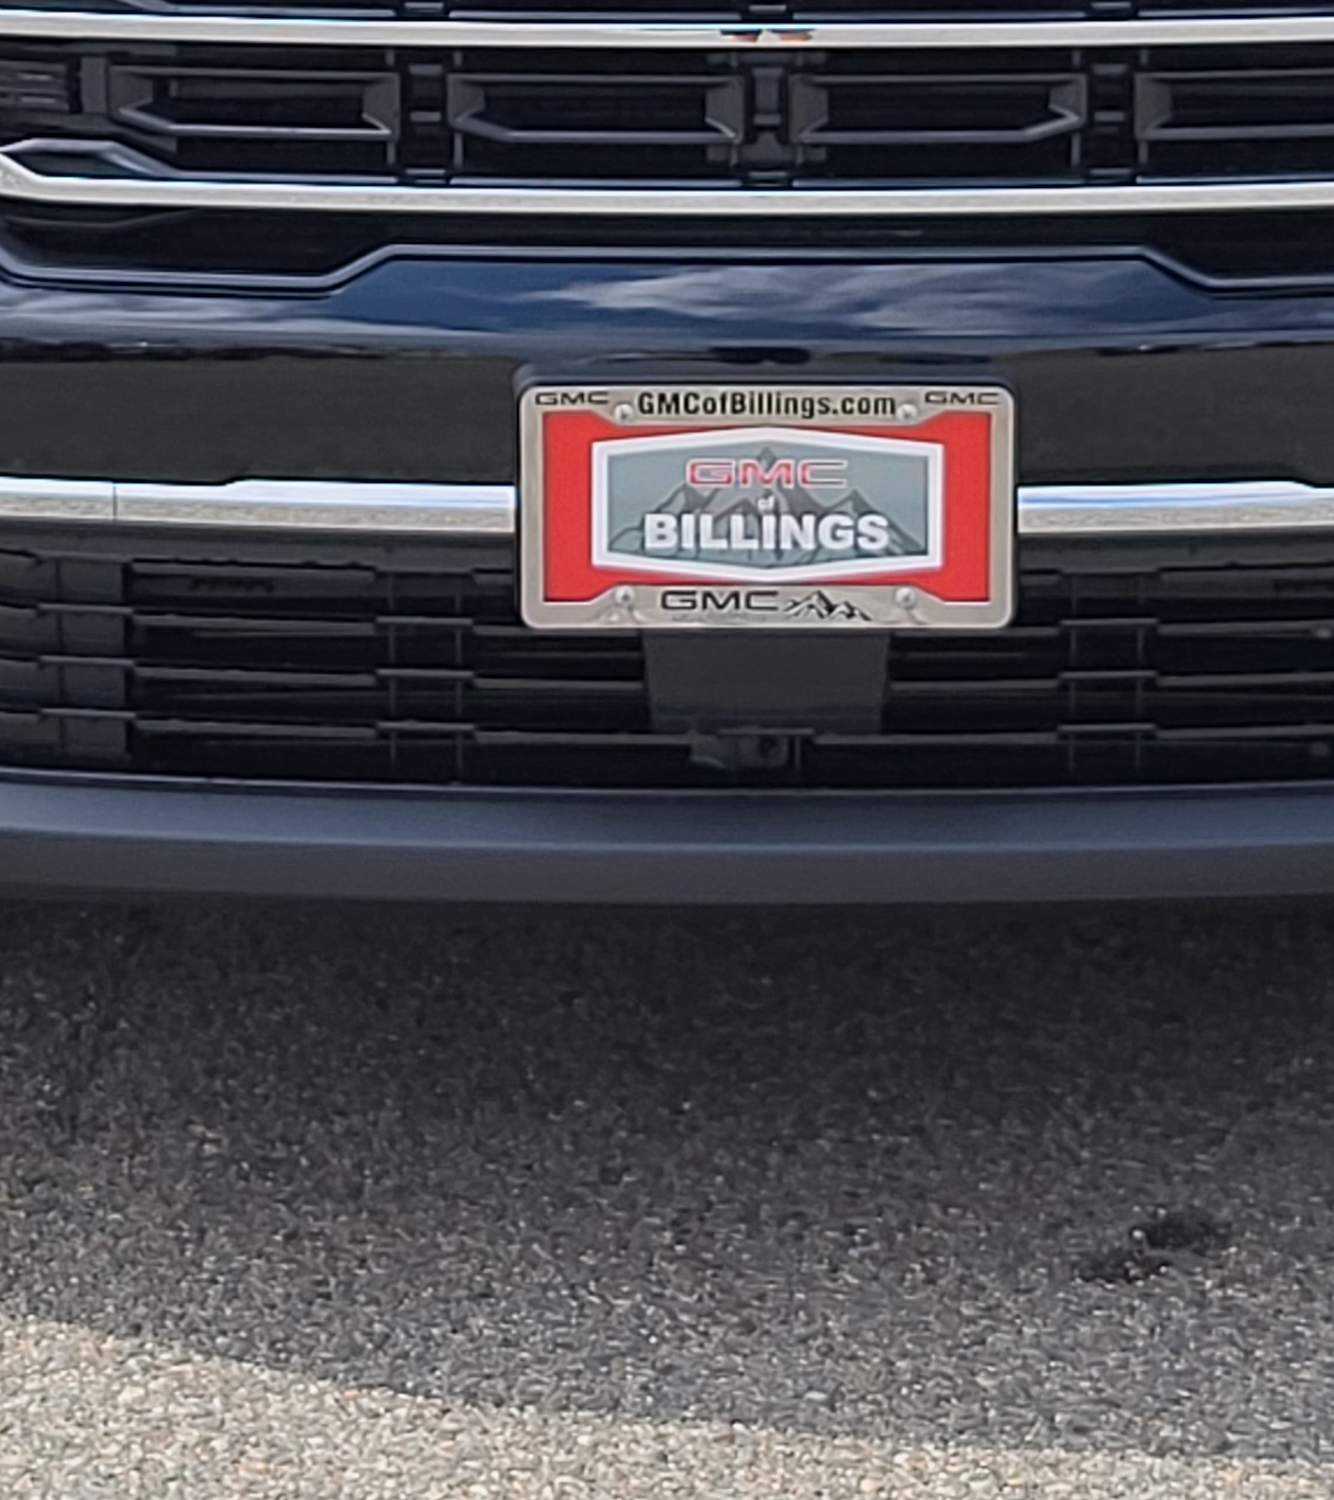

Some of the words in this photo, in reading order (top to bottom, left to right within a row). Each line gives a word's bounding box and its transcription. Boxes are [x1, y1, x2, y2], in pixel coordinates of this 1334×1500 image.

[535, 391, 609, 406] GMC
[637, 391, 896, 419] GMCofBillings.com
[924, 391, 1000, 405] GMC
[687, 458, 848, 489] GMC
[644, 513, 889, 551] BILLINGS
[660, 590, 779, 612] GMC
